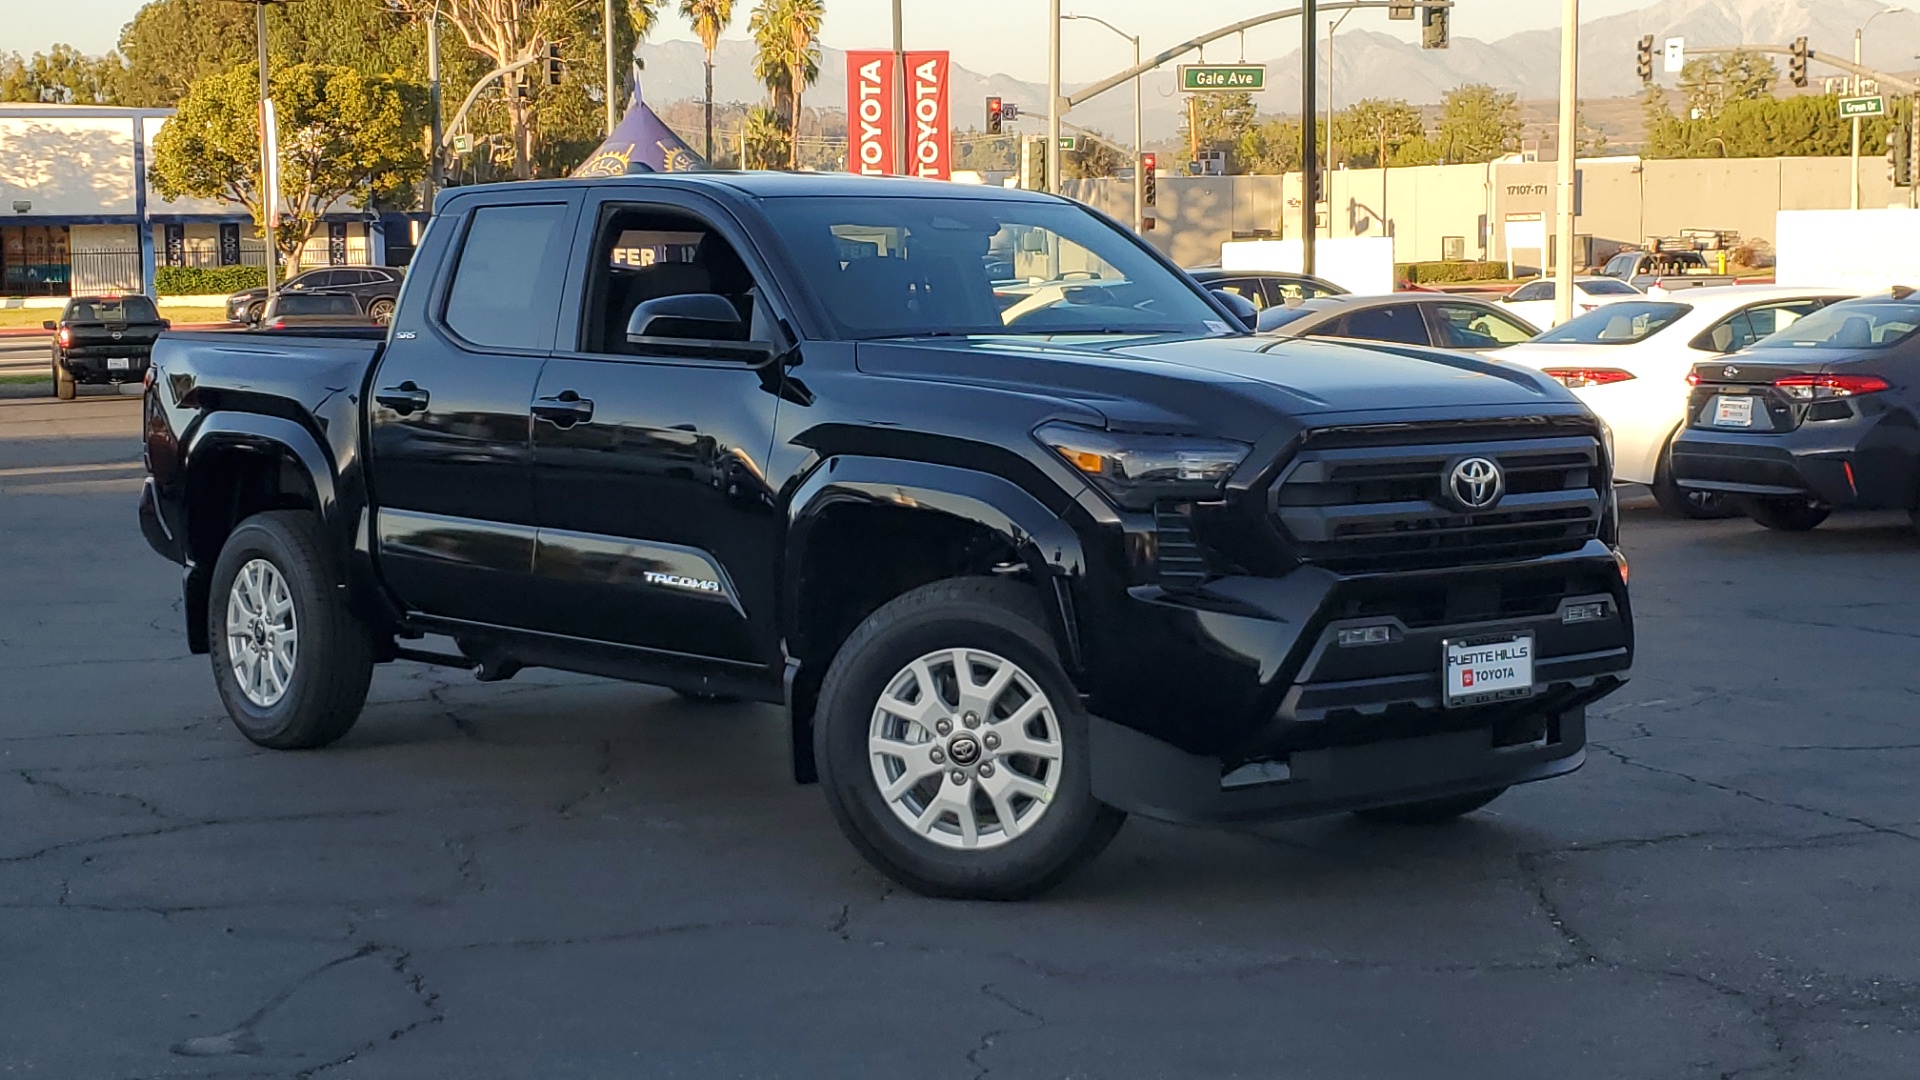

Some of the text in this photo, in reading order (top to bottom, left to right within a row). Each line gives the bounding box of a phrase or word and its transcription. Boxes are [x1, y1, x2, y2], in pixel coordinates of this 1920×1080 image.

[1196, 72, 1253, 85] Gale Ave
[859, 59, 882, 175] TOYOTA
[915, 59, 939, 177] TOYOTA
[643, 571, 720, 592] TACOMA
[1447, 646, 1528, 667] PUENTE HILLS
[1475, 667, 1515, 682] TOYOTA
